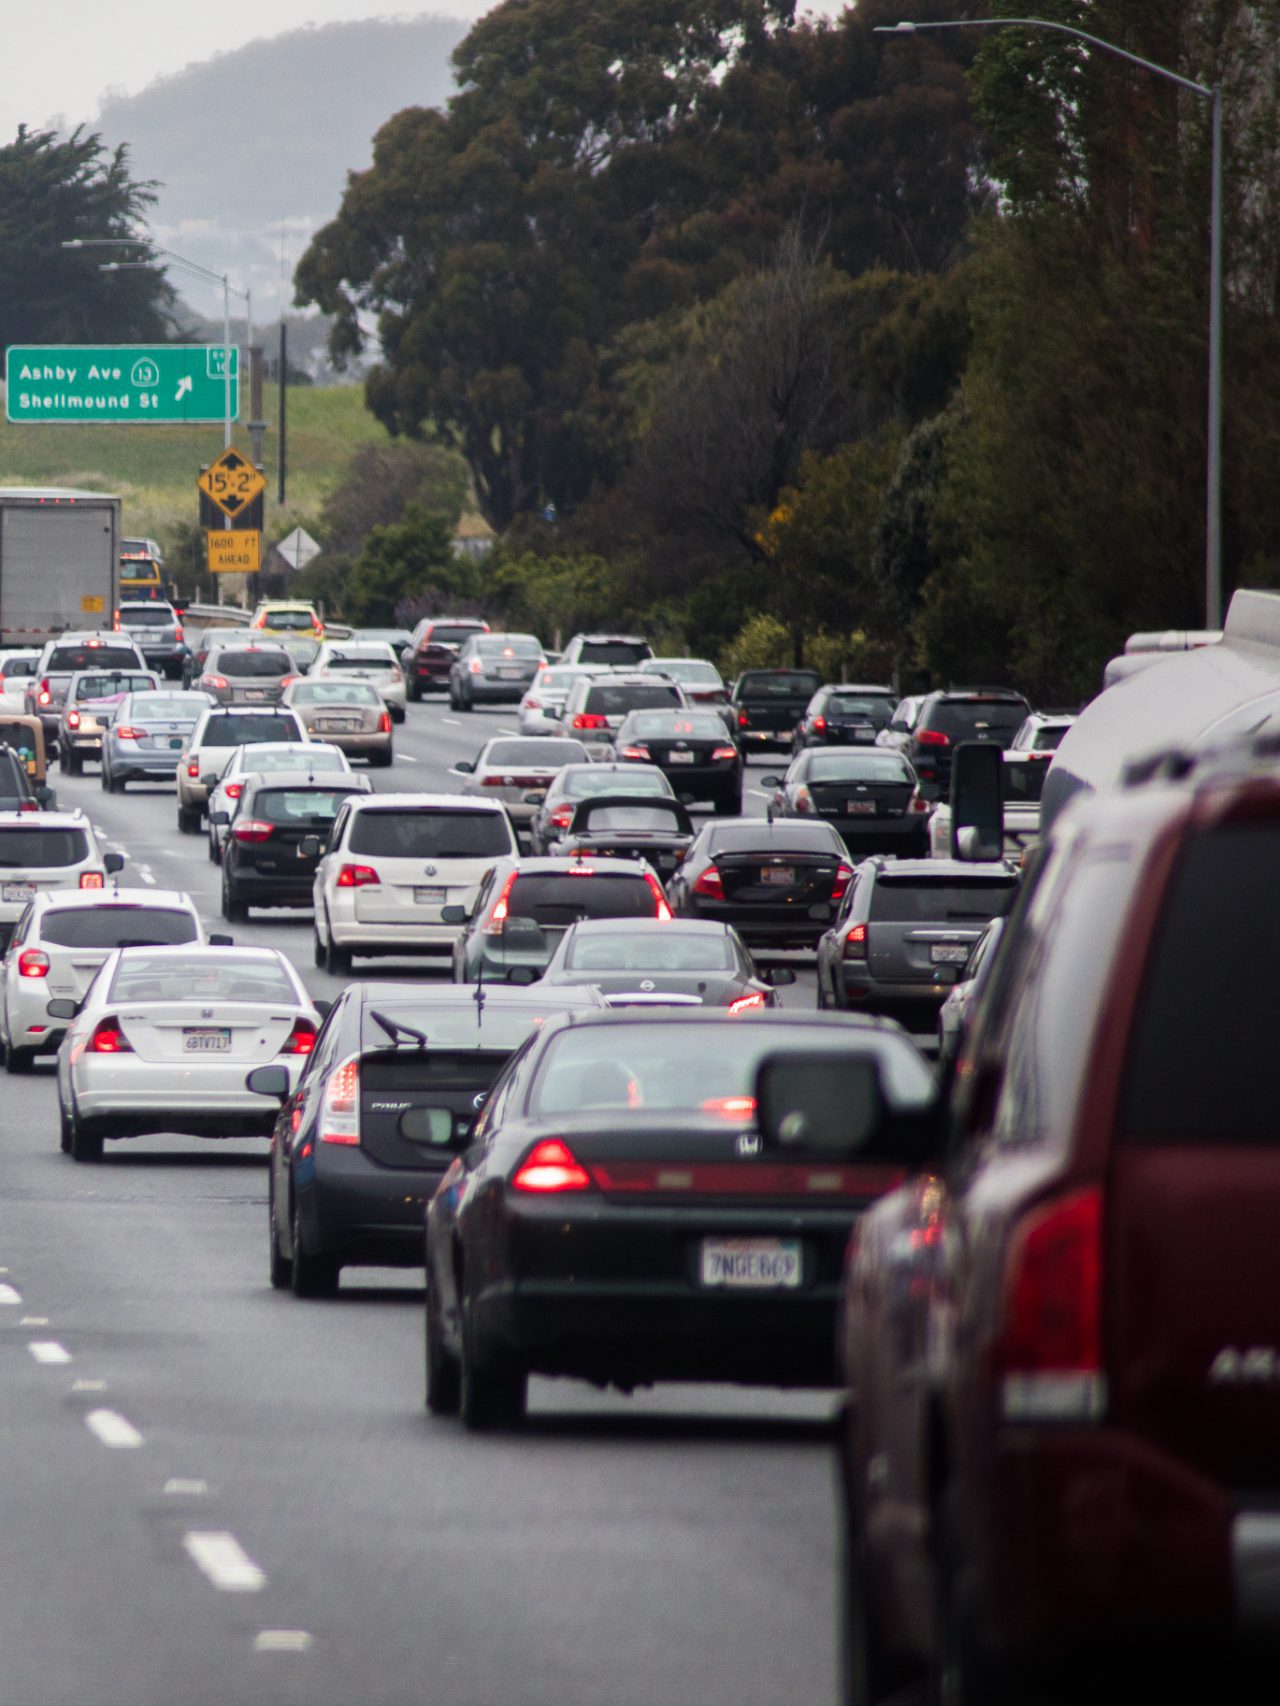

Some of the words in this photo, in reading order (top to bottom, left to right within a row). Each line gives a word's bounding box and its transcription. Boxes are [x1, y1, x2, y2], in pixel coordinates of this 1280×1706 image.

[19, 365, 77, 383] Ashby
[88, 365, 122, 381] Ave
[137, 367, 152, 382] 13
[19, 393, 130, 409] Shellmound
[139, 393, 160, 409] St
[210, 537, 234, 549] 1600
[244, 537, 257, 549] FT
[218, 554, 250, 565] AHEAD
